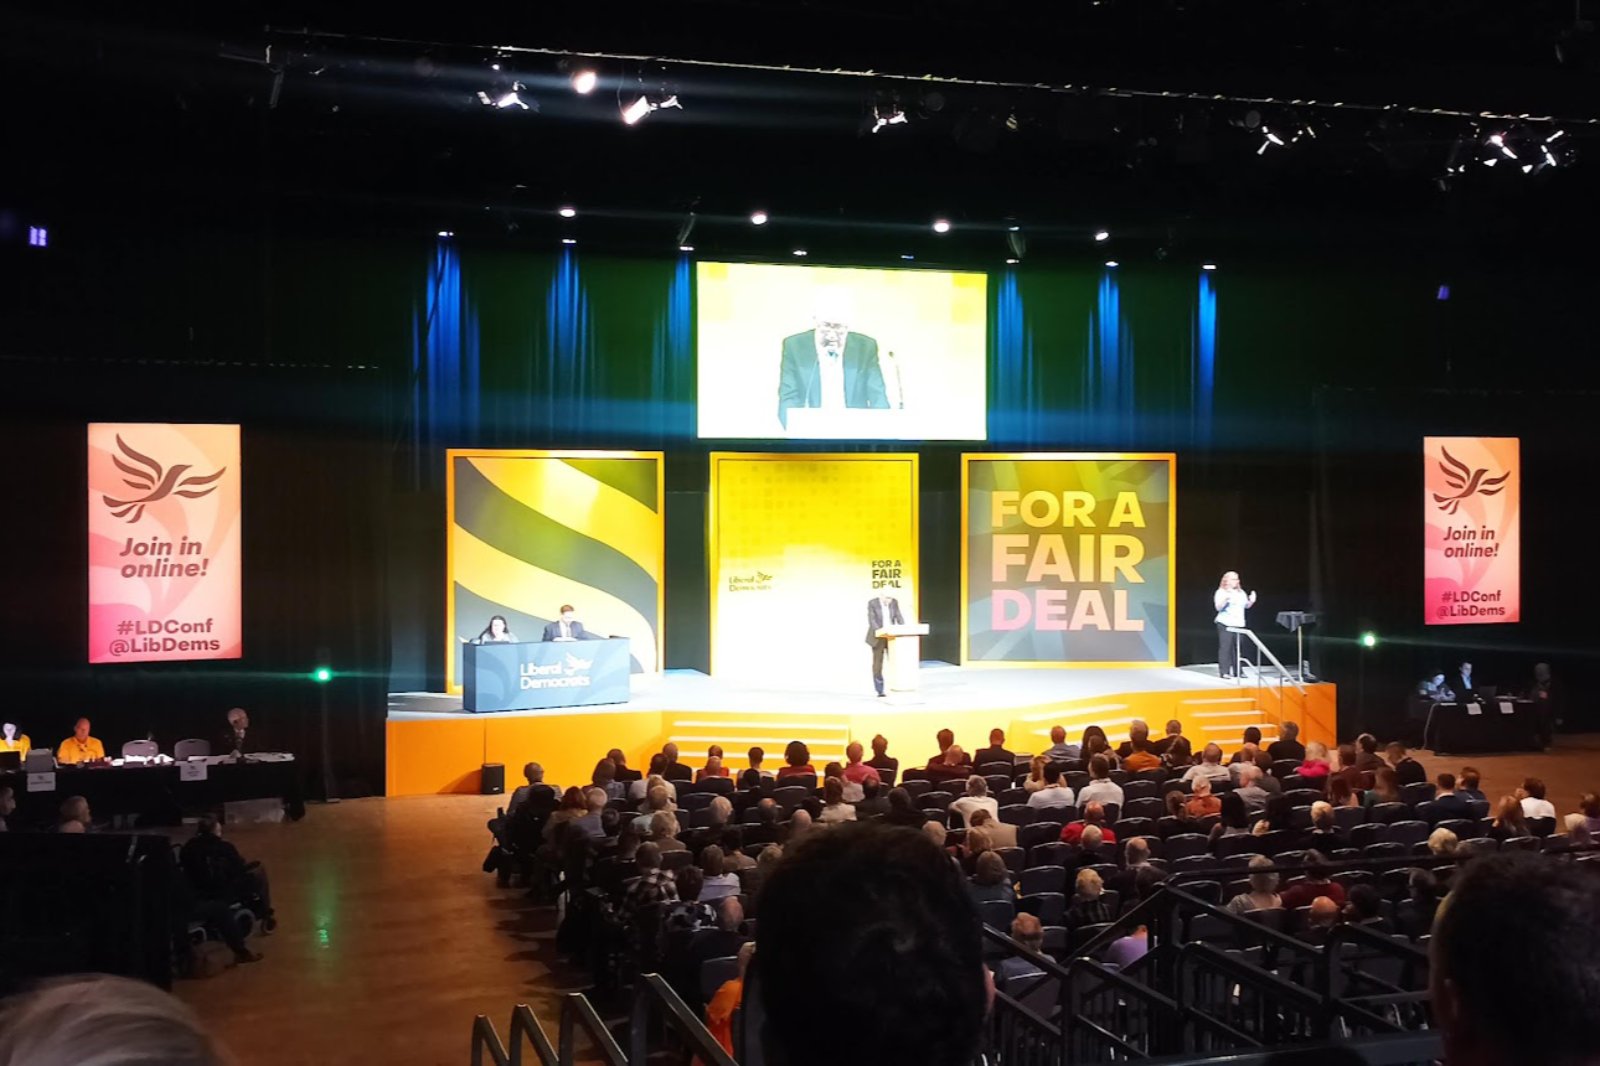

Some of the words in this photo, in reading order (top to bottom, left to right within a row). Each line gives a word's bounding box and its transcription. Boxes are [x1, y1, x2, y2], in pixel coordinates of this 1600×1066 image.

[992, 490, 1096, 528] FOR
[1108, 491, 1146, 528] A
[1443, 525, 1477, 541] Join
[1481, 525, 1496, 540] in
[119, 536, 173, 557] Join
[179, 535, 203, 555] in
[1444, 543, 1500, 558] online!
[871, 559, 893, 568] FOR
[894, 559, 902, 568] A
[992, 534, 1146, 584] FAIR
[120, 558, 209, 579] online!
[872, 568, 902, 579] FAIR
[1441, 590, 1502, 602] #LDConf
[992, 589, 1145, 632] DEAL
[1437, 605, 1506, 619] @LibDems
[116, 618, 213, 635] #LDConf
[109, 637, 220, 657] @LibDems
[520, 661, 562, 676] Liberal
[520, 676, 591, 690] Democrats
